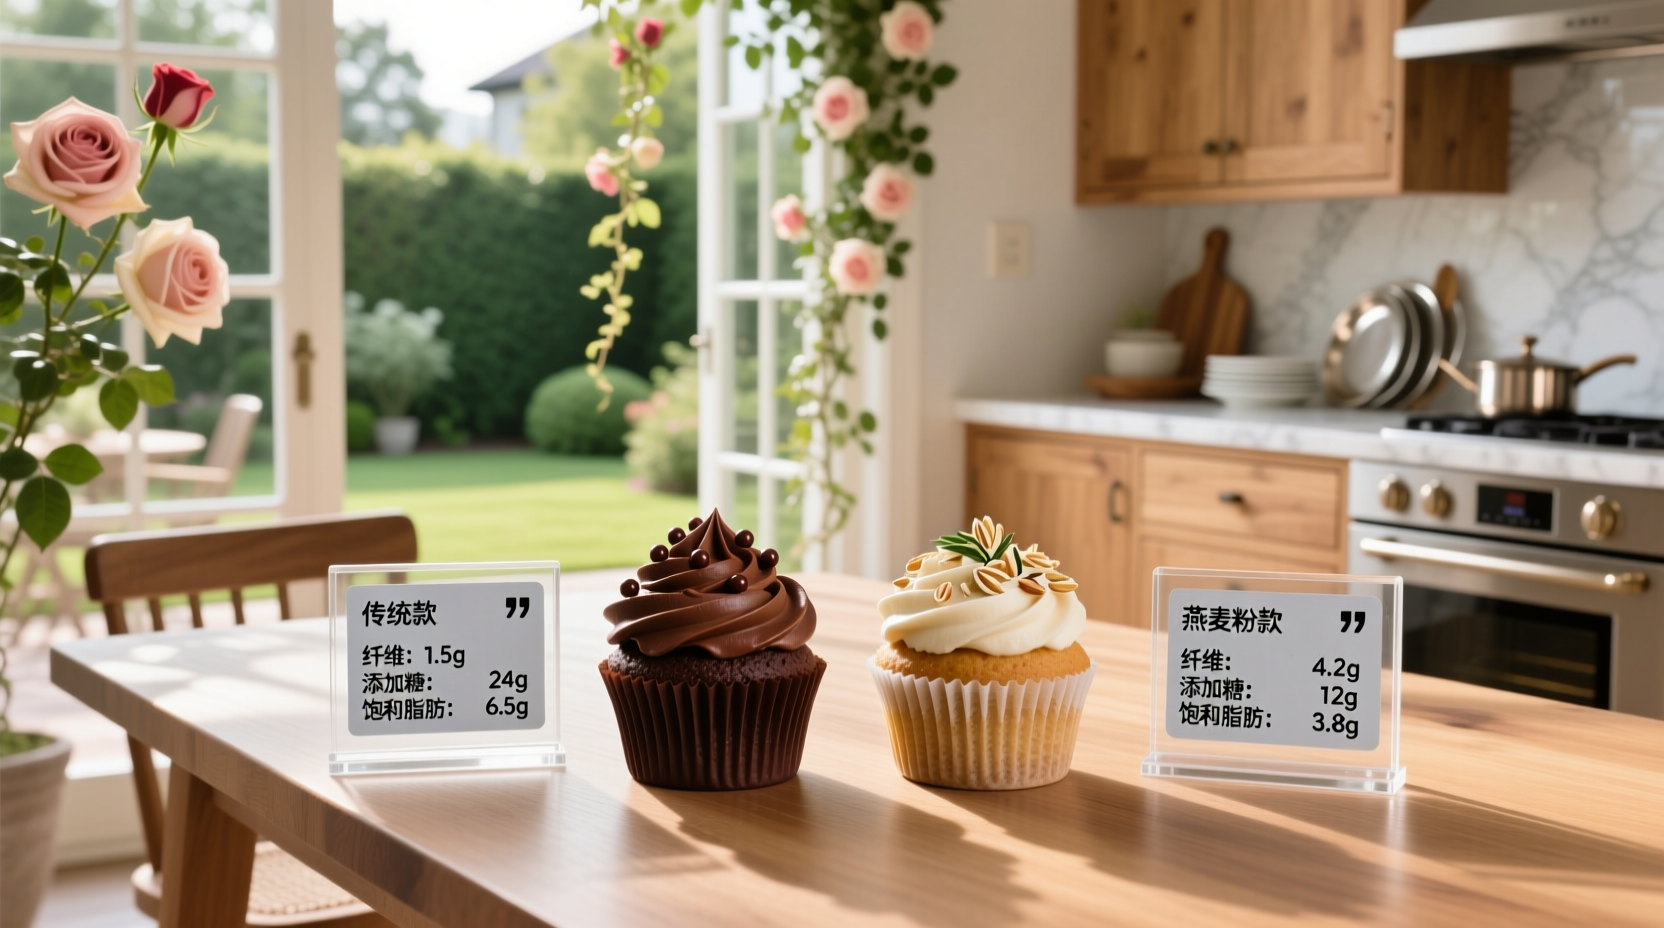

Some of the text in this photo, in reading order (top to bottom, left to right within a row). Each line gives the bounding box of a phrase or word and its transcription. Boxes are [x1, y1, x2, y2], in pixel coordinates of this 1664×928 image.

[361, 599, 437, 627] 传统款
[1181, 604, 1283, 635] 燕麦粉款
[424, 644, 465, 669] 1.5g
[1311, 656, 1360, 683] 4.2g
[488, 669, 528, 694] 24g
[485, 696, 529, 720] 6.5g
[1320, 685, 1358, 712] 12g
[1312, 711, 1359, 740] 3.8g
